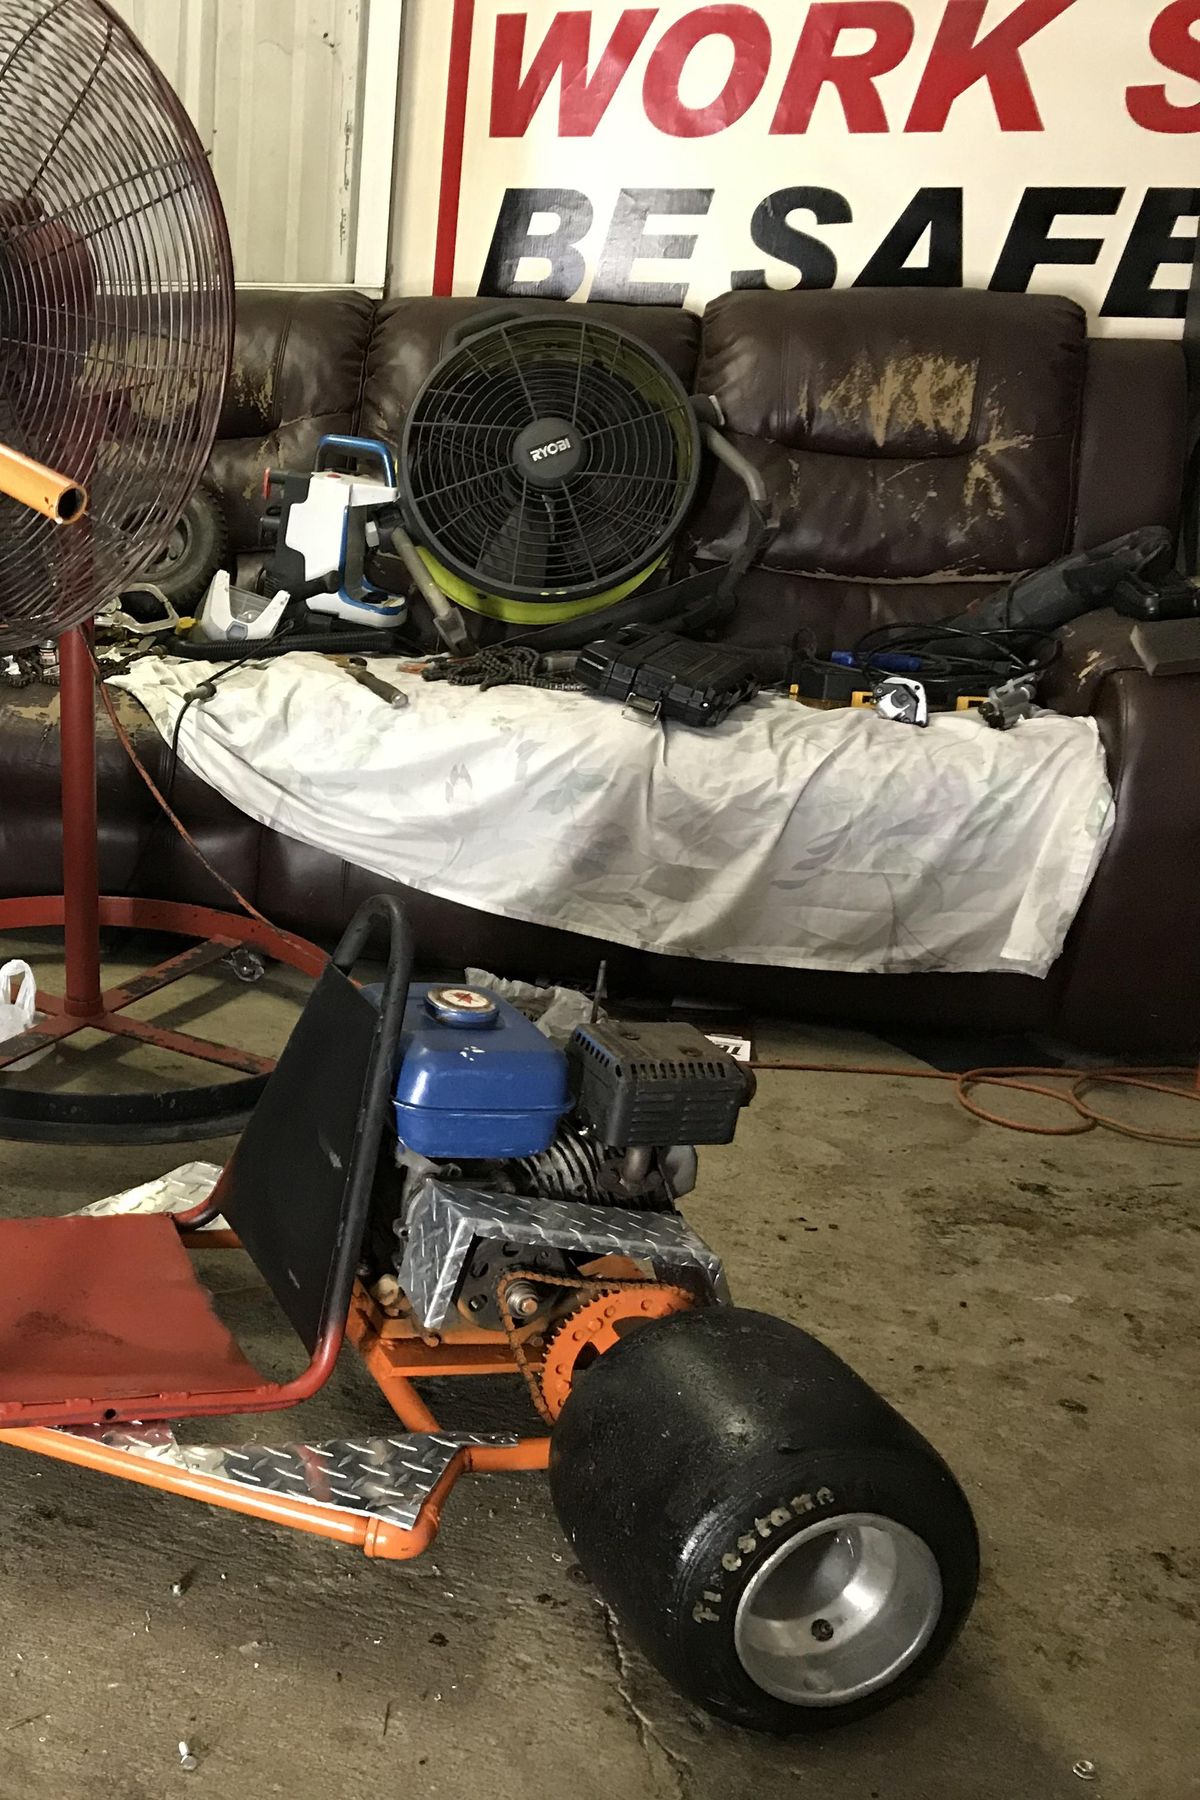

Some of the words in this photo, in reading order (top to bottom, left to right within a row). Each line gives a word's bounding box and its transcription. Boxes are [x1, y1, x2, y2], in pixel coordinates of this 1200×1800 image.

[489, 0, 1077, 139] WORK
[476, 187, 716, 308] BE
[730, 185, 1200, 319] SAFE
[529, 437, 571, 462] RYOBI
